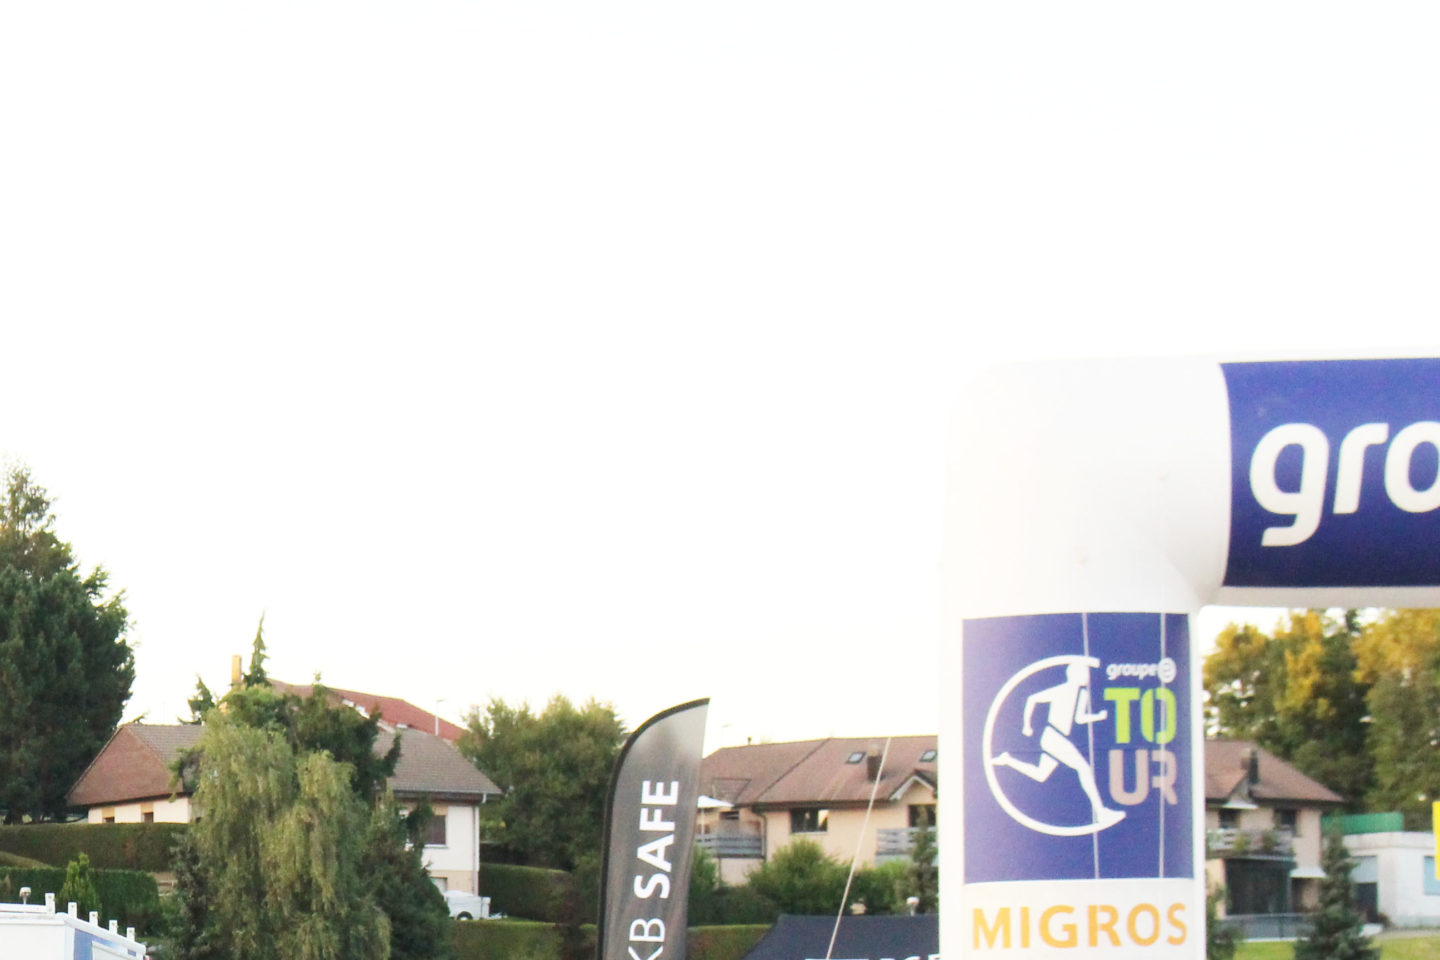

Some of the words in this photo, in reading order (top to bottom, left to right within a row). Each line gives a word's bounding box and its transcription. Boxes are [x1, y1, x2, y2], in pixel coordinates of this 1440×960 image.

[1250, 421, 1440, 547] gro
[1104, 687, 1177, 744] TO
[1110, 750, 1178, 806] UR
[633, 781, 679, 899] SAFE
[972, 902, 1187, 949] MIGROS
